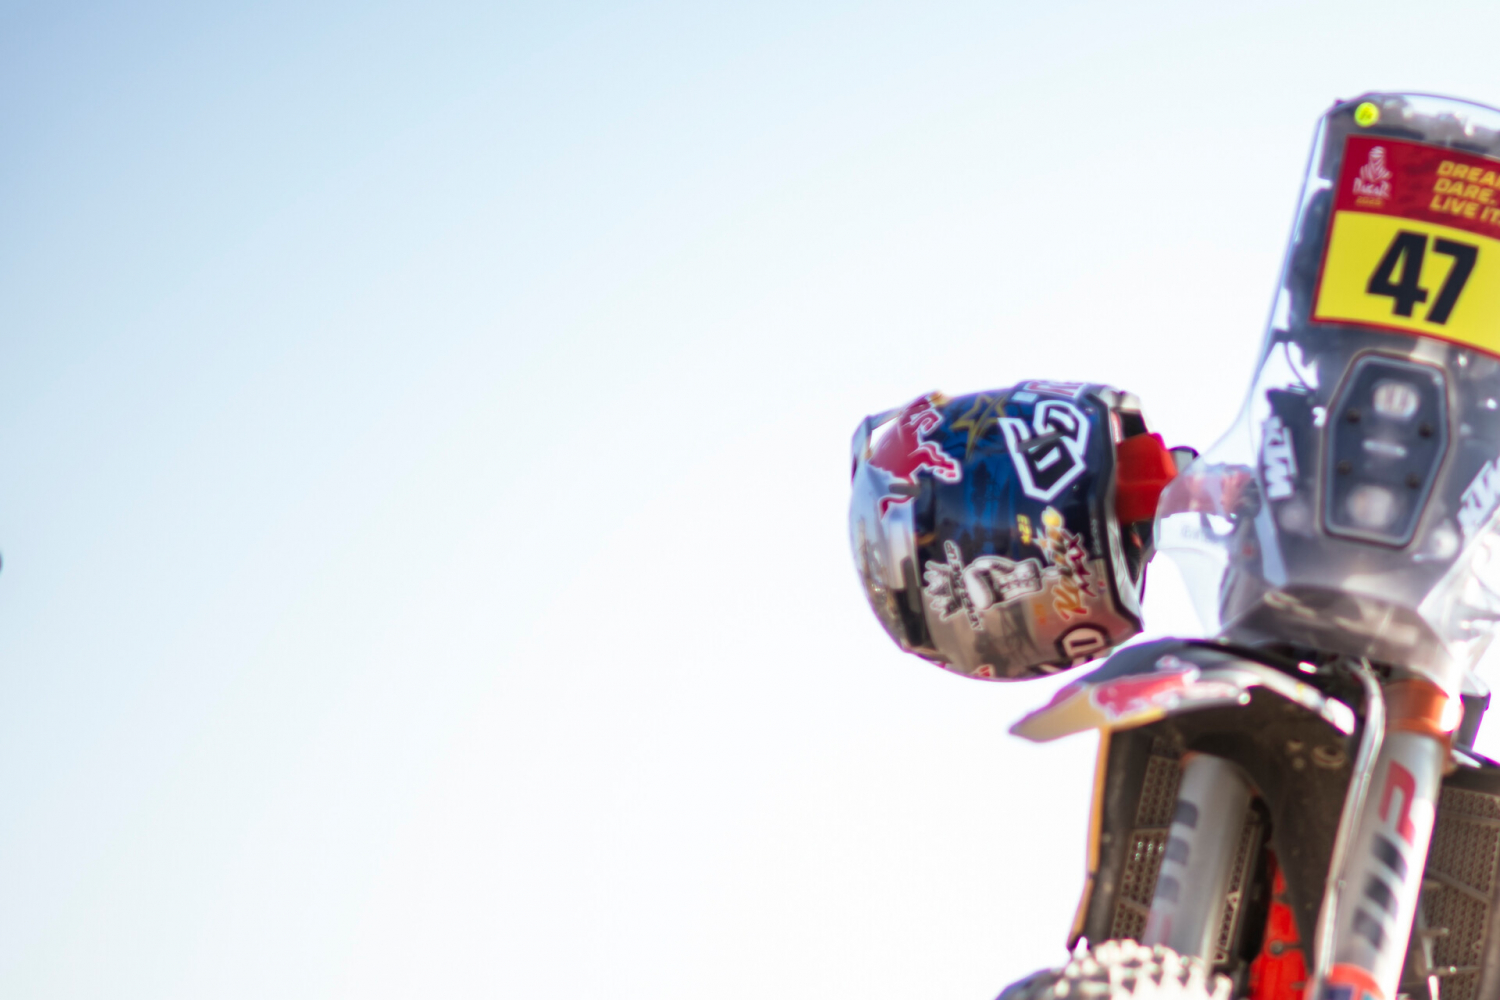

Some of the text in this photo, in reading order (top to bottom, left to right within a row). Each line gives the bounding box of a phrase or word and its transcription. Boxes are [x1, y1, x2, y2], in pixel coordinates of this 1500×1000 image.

[1429, 194, 1480, 220] LIVE
[1433, 178, 1498, 207] DARE.
[1363, 229, 1480, 326] 47
